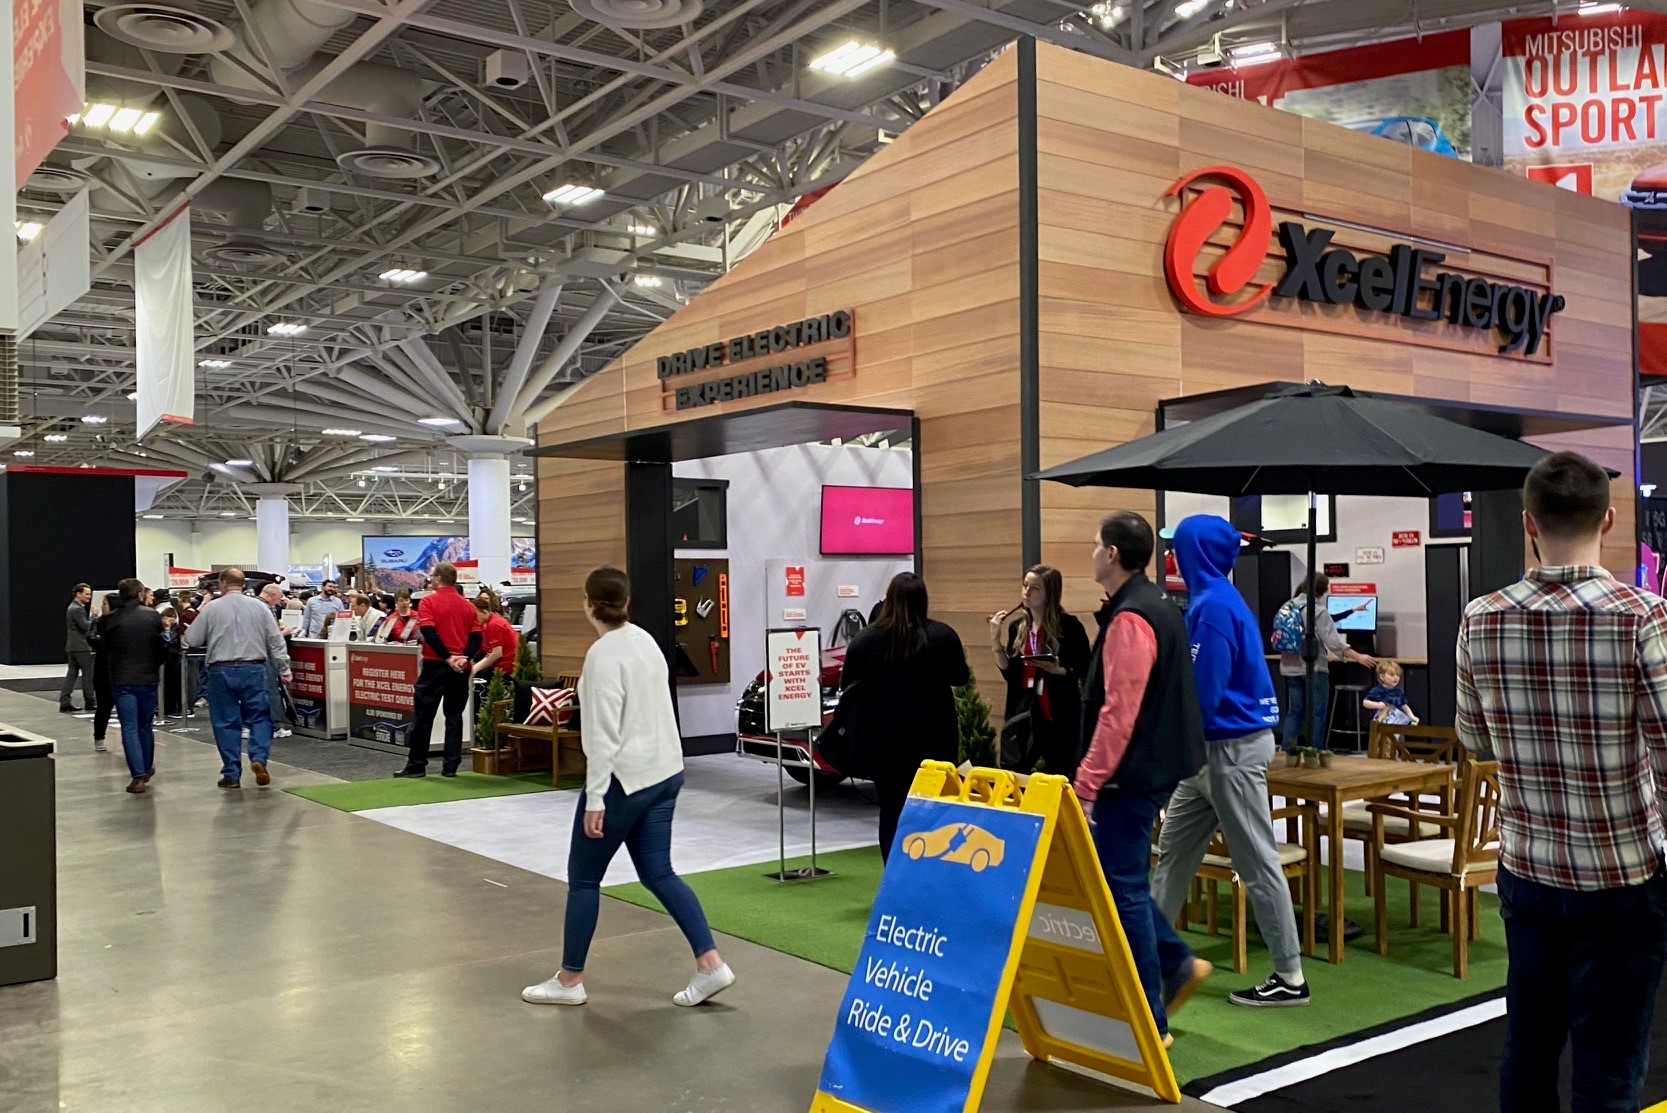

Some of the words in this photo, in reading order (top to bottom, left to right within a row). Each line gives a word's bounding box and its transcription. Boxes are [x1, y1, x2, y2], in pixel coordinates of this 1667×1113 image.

[1526, 24, 1642, 58] MITSUBISHI
[1524, 43, 1667, 99] OUTLA
[1524, 94, 1663, 148] SPORT
[657, 342, 723, 379] DRIVE
[728, 310, 850, 362] ELECTRIC
[676, 356, 827, 410] EXPERIENCE
[353, 679, 364, 687] FOR
[365, 680, 376, 688] THE
[377, 681, 391, 691] XCEL
[392, 683, 415, 693] ENERGY
[362, 668, 389, 678] REGISTER
[390, 670, 406, 680] HERE
[355, 690, 380, 700] ELECTRIC
[381, 693, 395, 703] TEST
[396, 695, 415, 706] DRIVE
[876, 914, 948, 958] Electric
[865, 956, 933, 1001] Vehicle
[847, 998, 892, 1037] Ride
[893, 1014, 911, 1044] &
[911, 1019, 970, 1062] Drive
